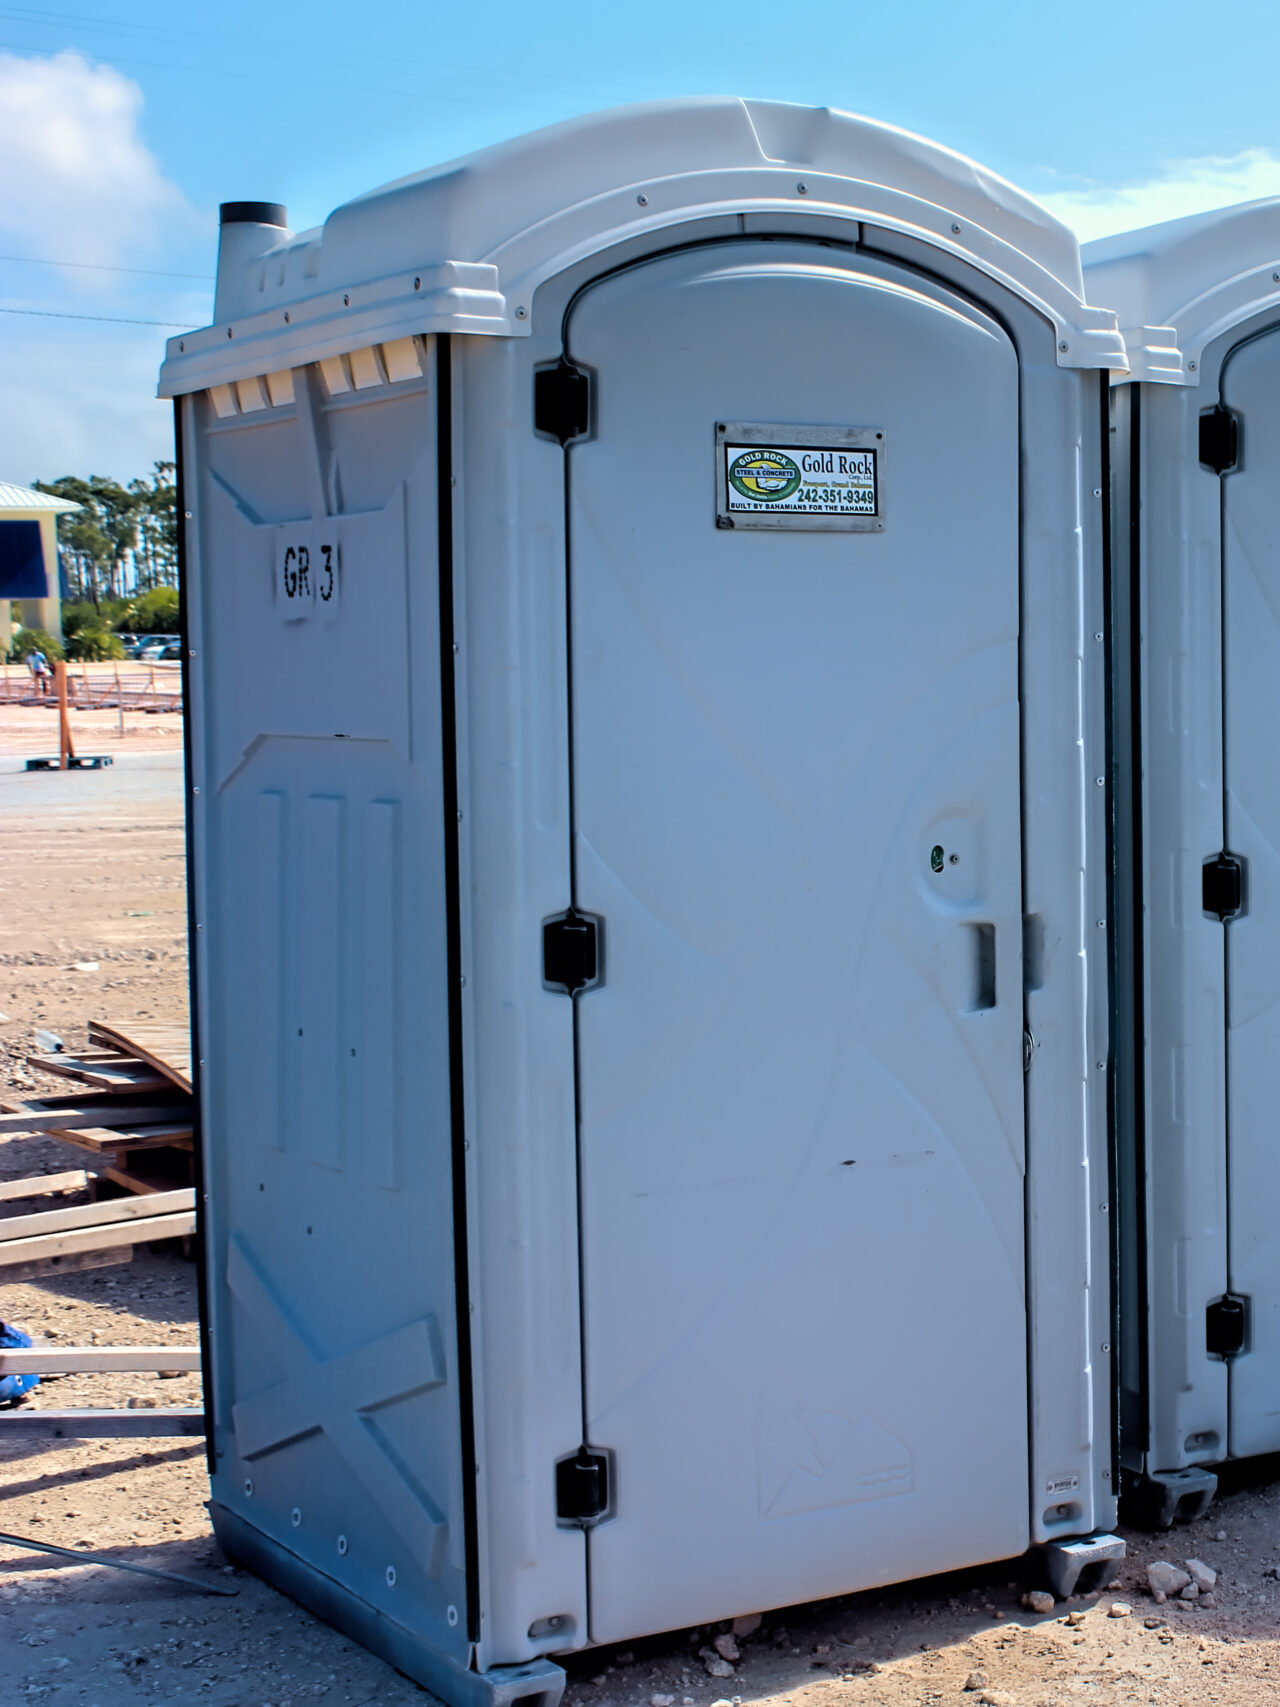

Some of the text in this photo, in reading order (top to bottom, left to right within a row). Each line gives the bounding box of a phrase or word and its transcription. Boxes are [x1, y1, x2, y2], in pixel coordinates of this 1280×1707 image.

[739, 452, 788, 466] GOLD ROCK
[802, 453, 873, 475] Gold Rock
[797, 488, 874, 504] 242-351-9349
[320, 544, 333, 601] 3
